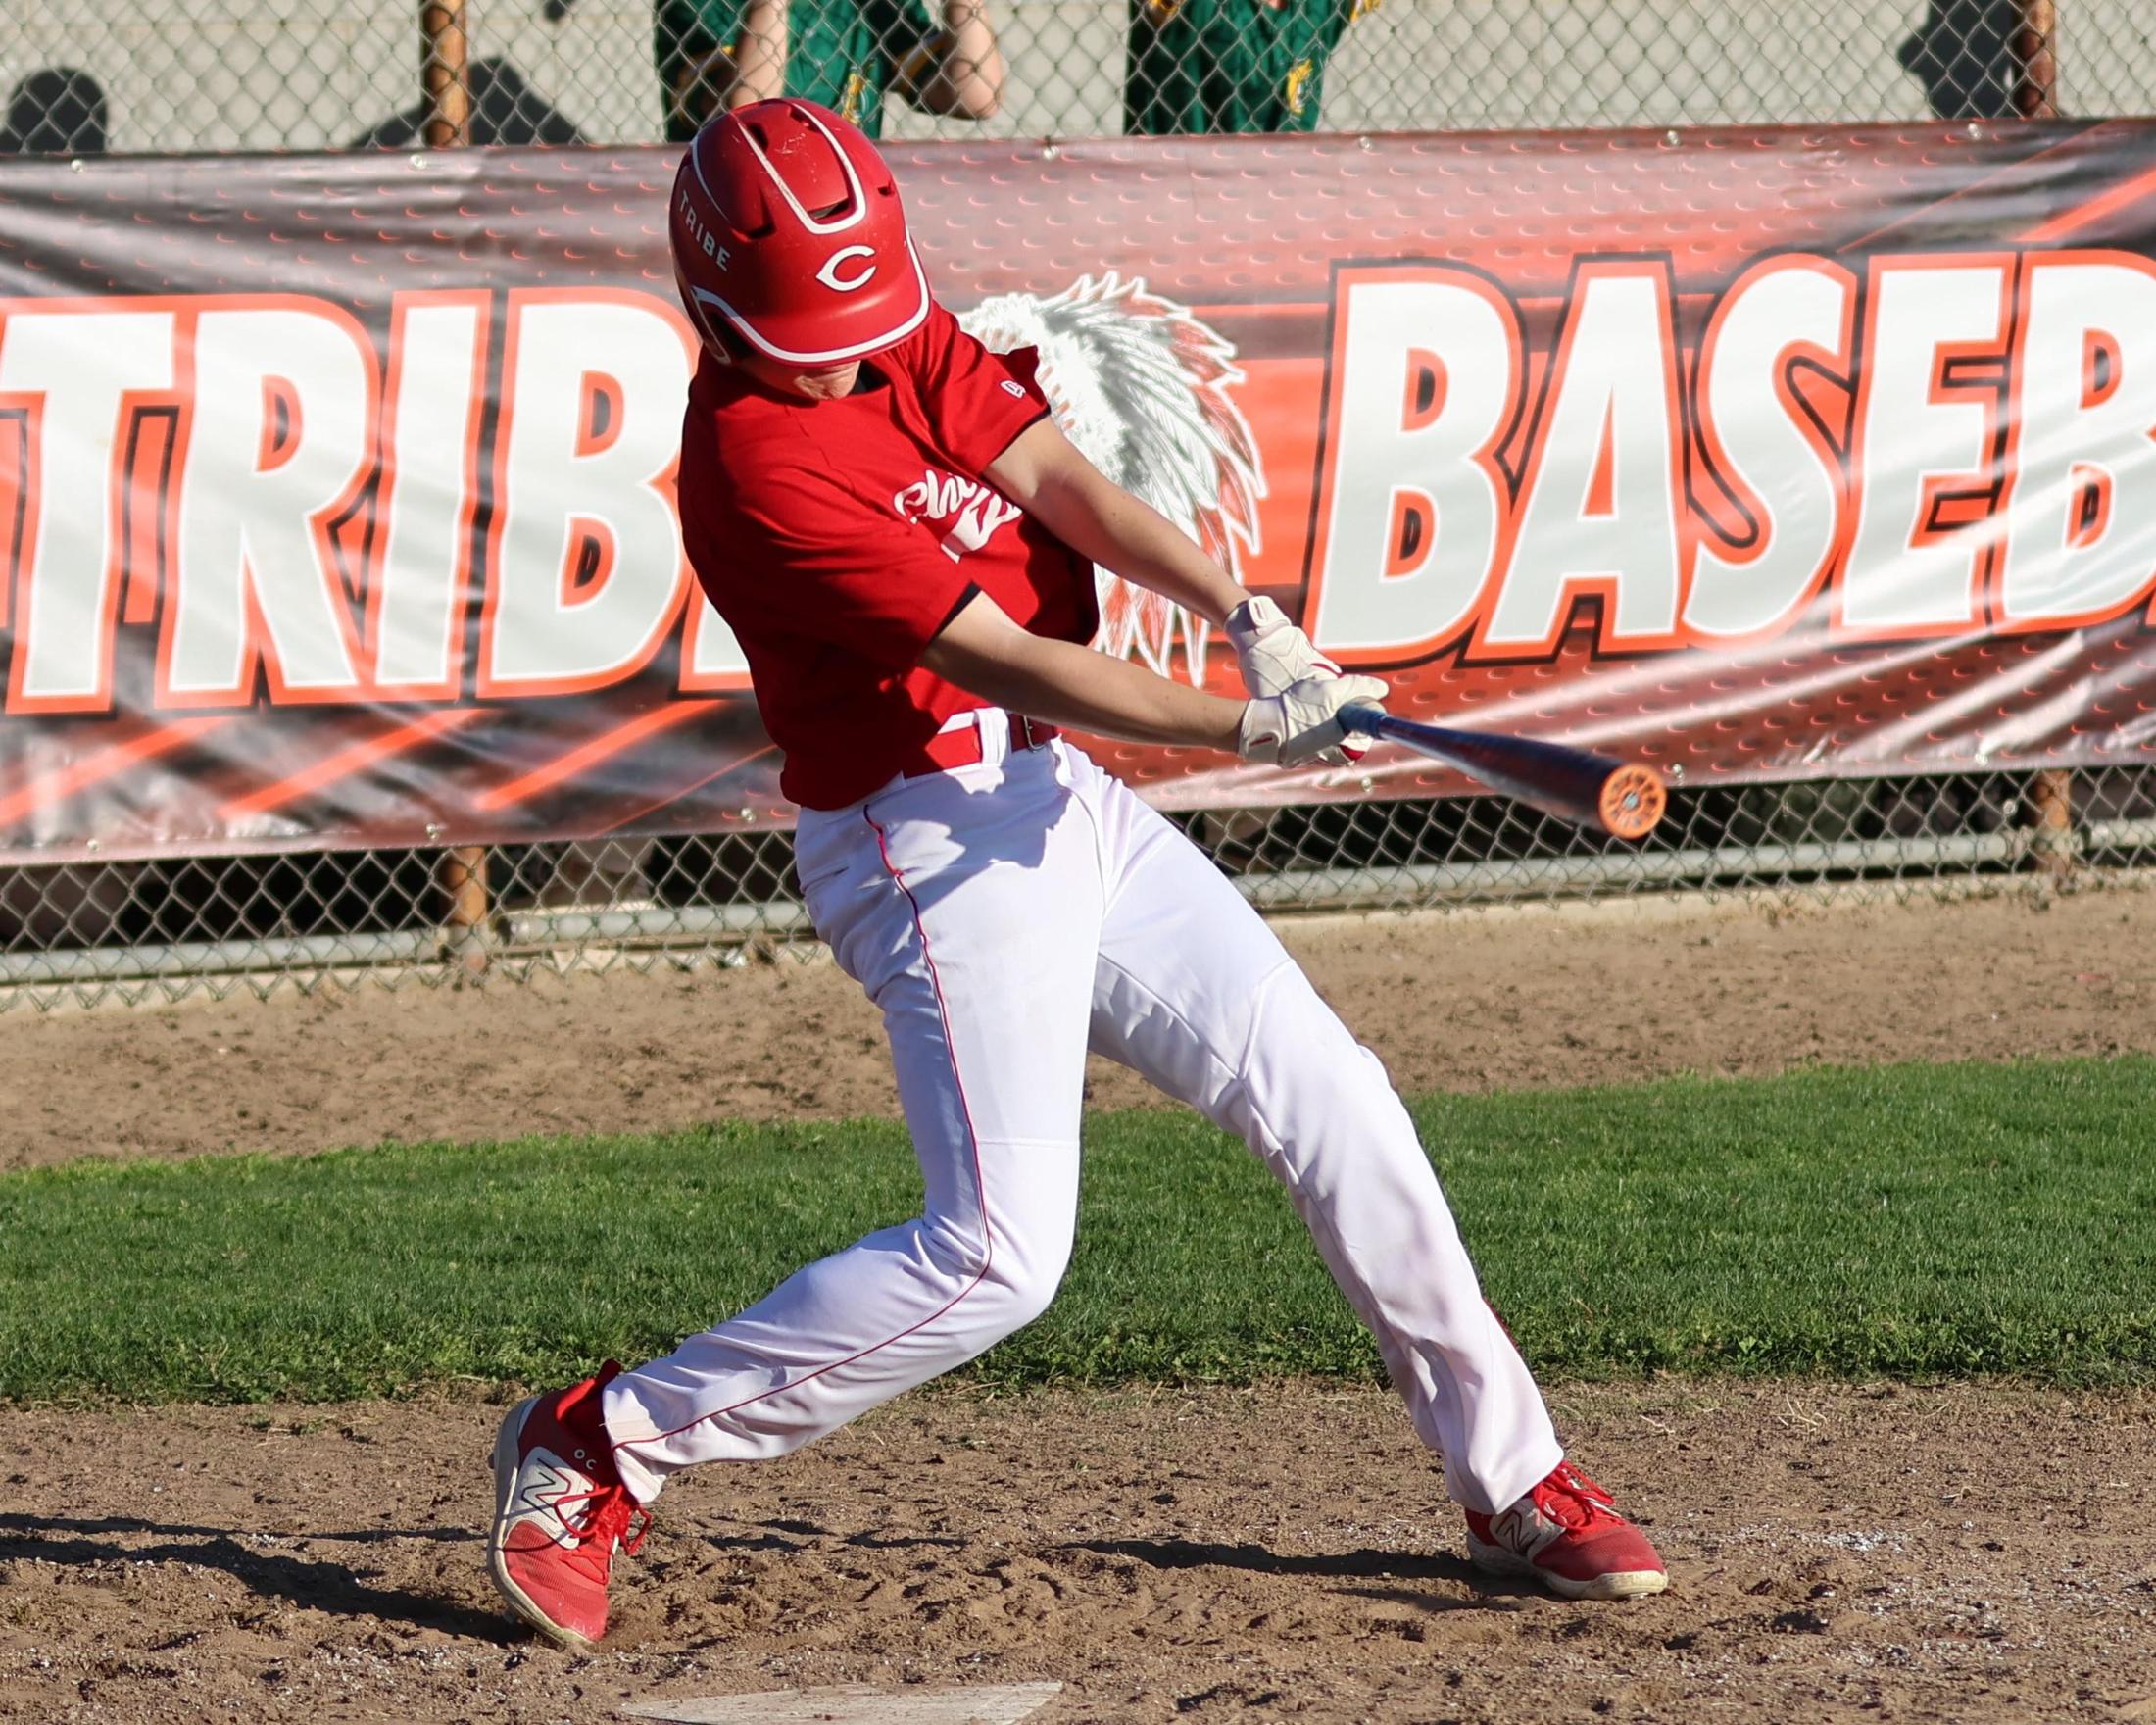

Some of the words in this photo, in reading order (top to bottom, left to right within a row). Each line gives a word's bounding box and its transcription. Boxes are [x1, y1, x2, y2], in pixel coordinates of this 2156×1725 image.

[680, 189, 731, 271] TRIBE
[815, 245, 877, 291] C
[0, 294, 753, 703] TRIB
[1308, 253, 2156, 661] BASEB
